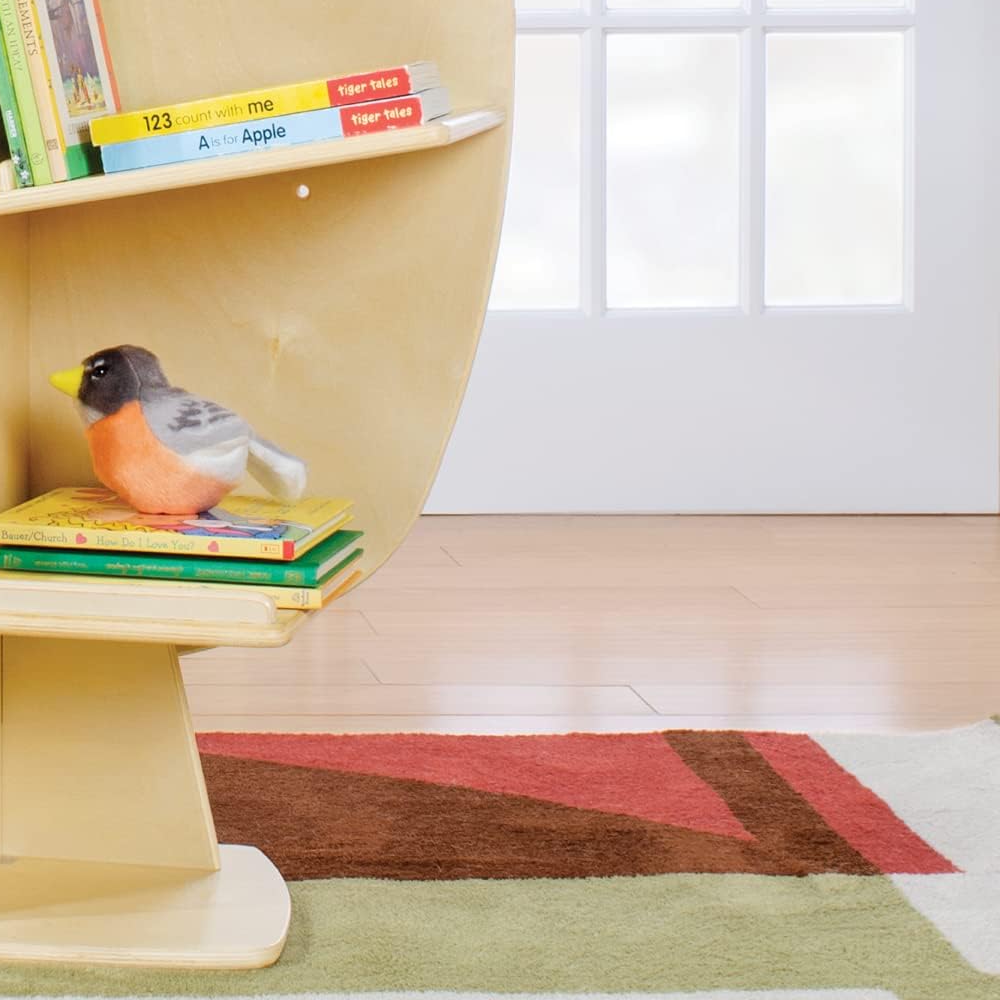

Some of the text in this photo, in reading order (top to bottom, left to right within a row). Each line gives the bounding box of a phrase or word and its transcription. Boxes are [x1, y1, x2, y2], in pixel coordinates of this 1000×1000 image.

[4, 22, 16, 38] AN
[337, 75, 398, 97] tiger tales
[143, 99, 274, 132] 123 count with me
[351, 104, 412, 127] tiger tales
[198, 124, 287, 150] A is for Apple
[1, 529, 195, 551] Bauer/Church How Do I Love You?
